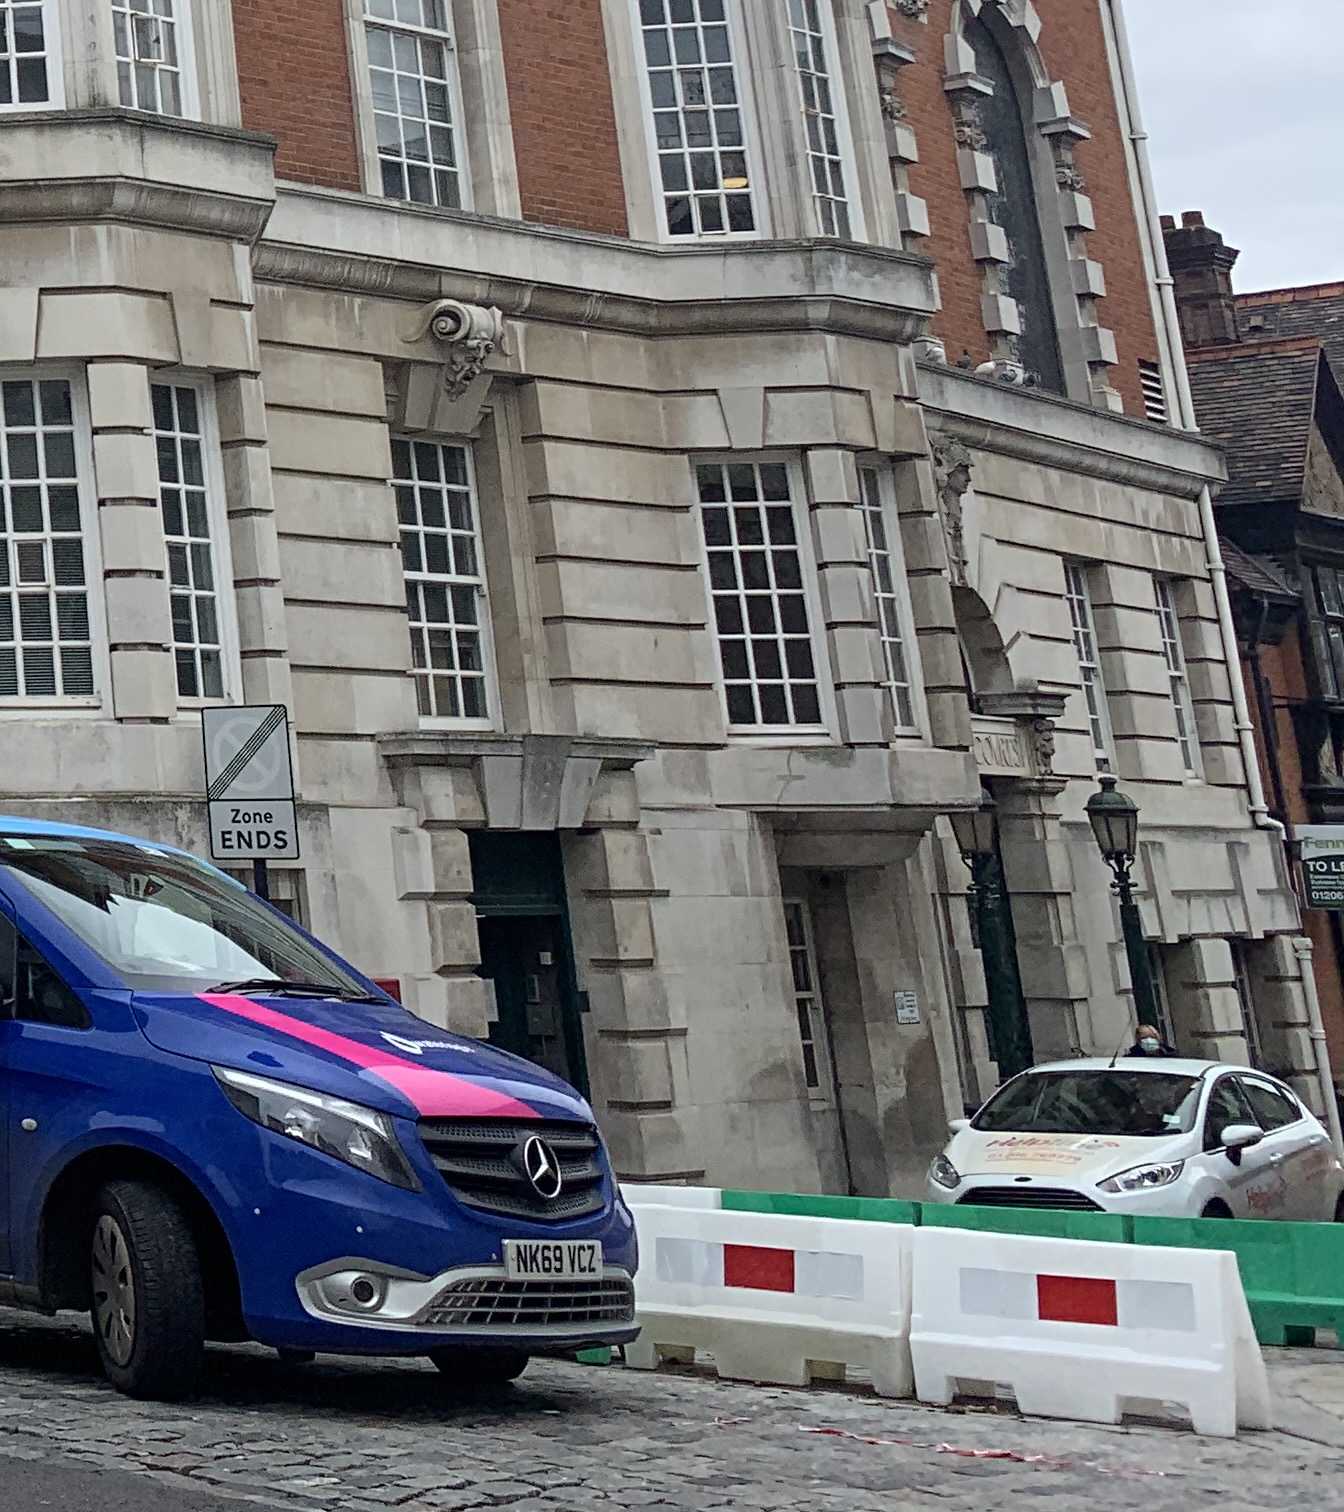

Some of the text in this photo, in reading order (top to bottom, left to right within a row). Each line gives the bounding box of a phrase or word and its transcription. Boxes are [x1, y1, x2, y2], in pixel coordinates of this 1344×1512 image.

[231, 809, 273, 823] Zone
[221, 830, 288, 849] ENDS
[1306, 861, 1327, 872] TO
[516, 1244, 596, 1273] NK69 VCZ
